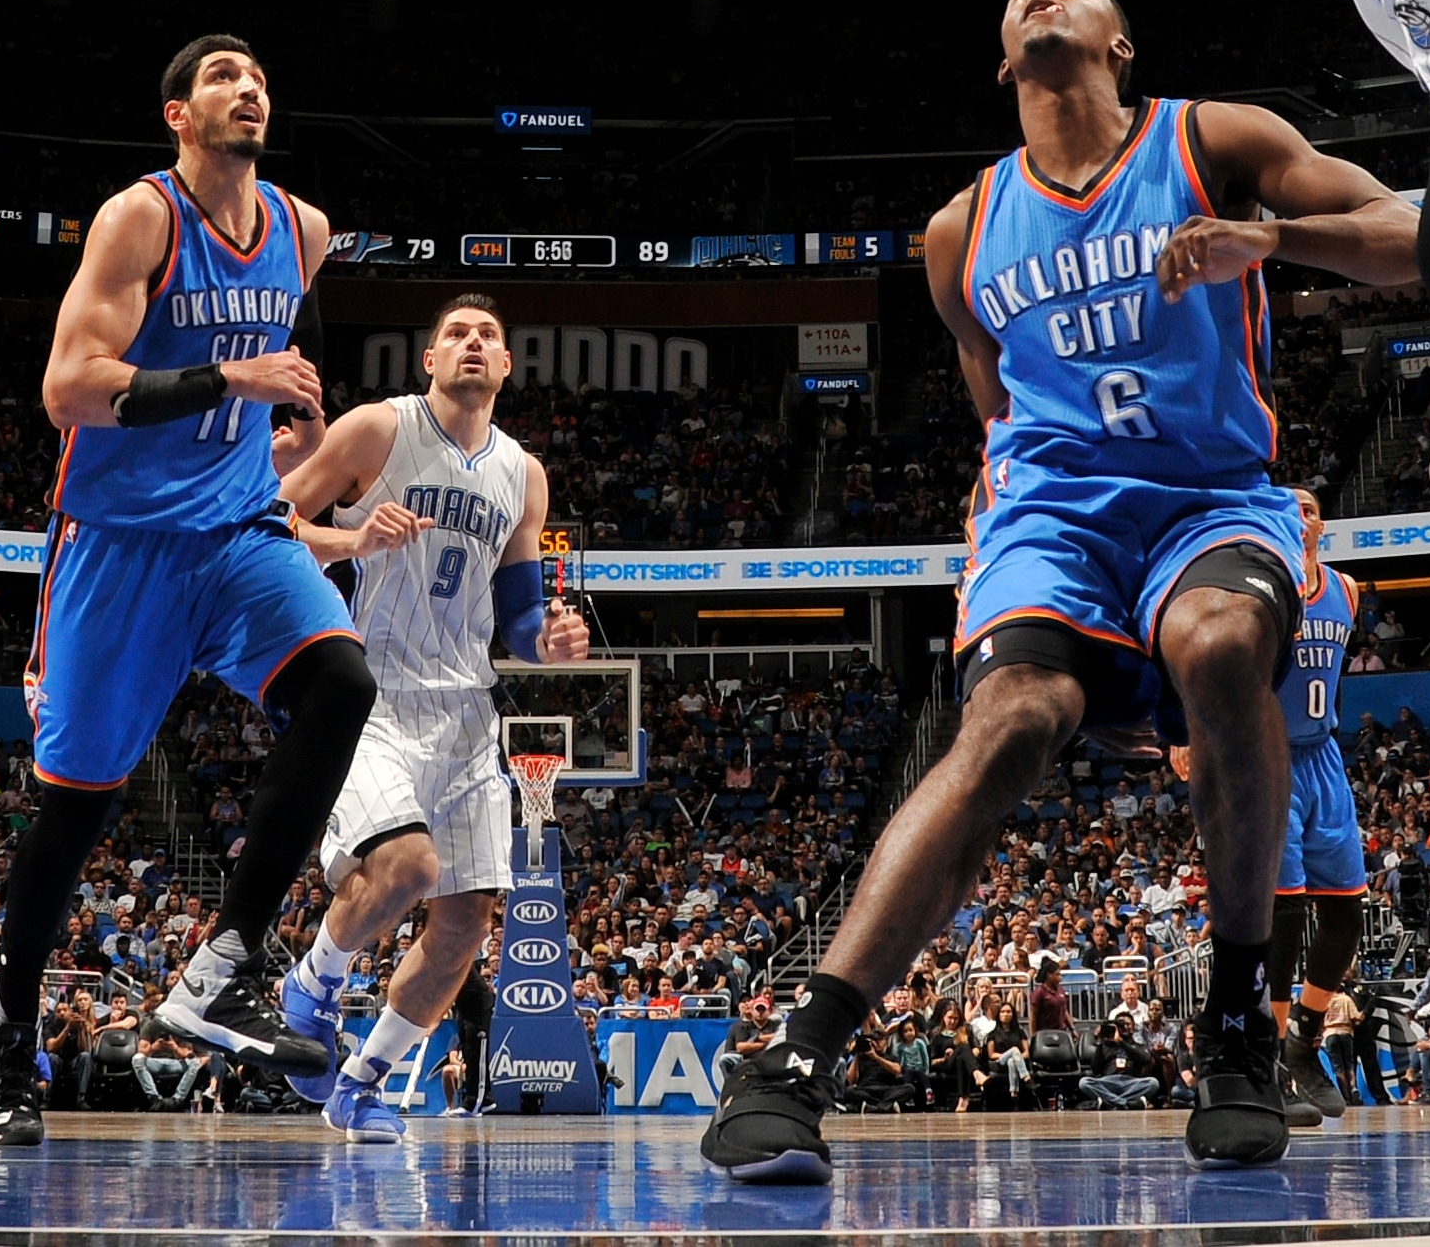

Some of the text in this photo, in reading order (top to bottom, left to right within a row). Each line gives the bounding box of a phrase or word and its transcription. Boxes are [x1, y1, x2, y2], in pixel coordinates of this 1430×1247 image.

[519, 113, 585, 128] FANDUEL
[59, 218, 80, 232] TIME
[58, 231, 80, 244] OUTS
[831, 236, 856, 248] TEAM
[864, 236, 879, 258] 5
[906, 234, 925, 245] TIM
[406, 238, 436, 260] 79
[469, 242, 505, 257] 4TH
[638, 241, 669, 263] 89
[829, 248, 856, 261] FOULS
[906, 246, 925, 258] OUT
[979, 221, 1174, 333] OKLAHOM
[171, 287, 300, 331] OKLAHOMA
[815, 328, 851, 341] 110A
[1047, 289, 1147, 359] CITY
[211, 332, 270, 366] CITY
[815, 343, 852, 356] 111A
[362, 325, 709, 395] OANDO
[817, 378, 861, 390] FANDUEL
[1091, 368, 1162, 441] 6
[402, 484, 512, 555] MAGIC
[540, 531, 569, 555] 56
[1353, 528, 1385, 549] BE
[429, 546, 468, 599] 9
[742, 560, 774, 580] BE
[776, 557, 925, 580] SPORTSRICH
[1295, 647, 1335, 670] CITY
[1307, 678, 1327, 720] 0
[520, 905, 551, 920] KIA
[517, 943, 553, 960] KIA
[513, 986, 557, 1006] KIA
[493, 1052, 578, 1083] Amway
[521, 1081, 564, 1093] CENTER
